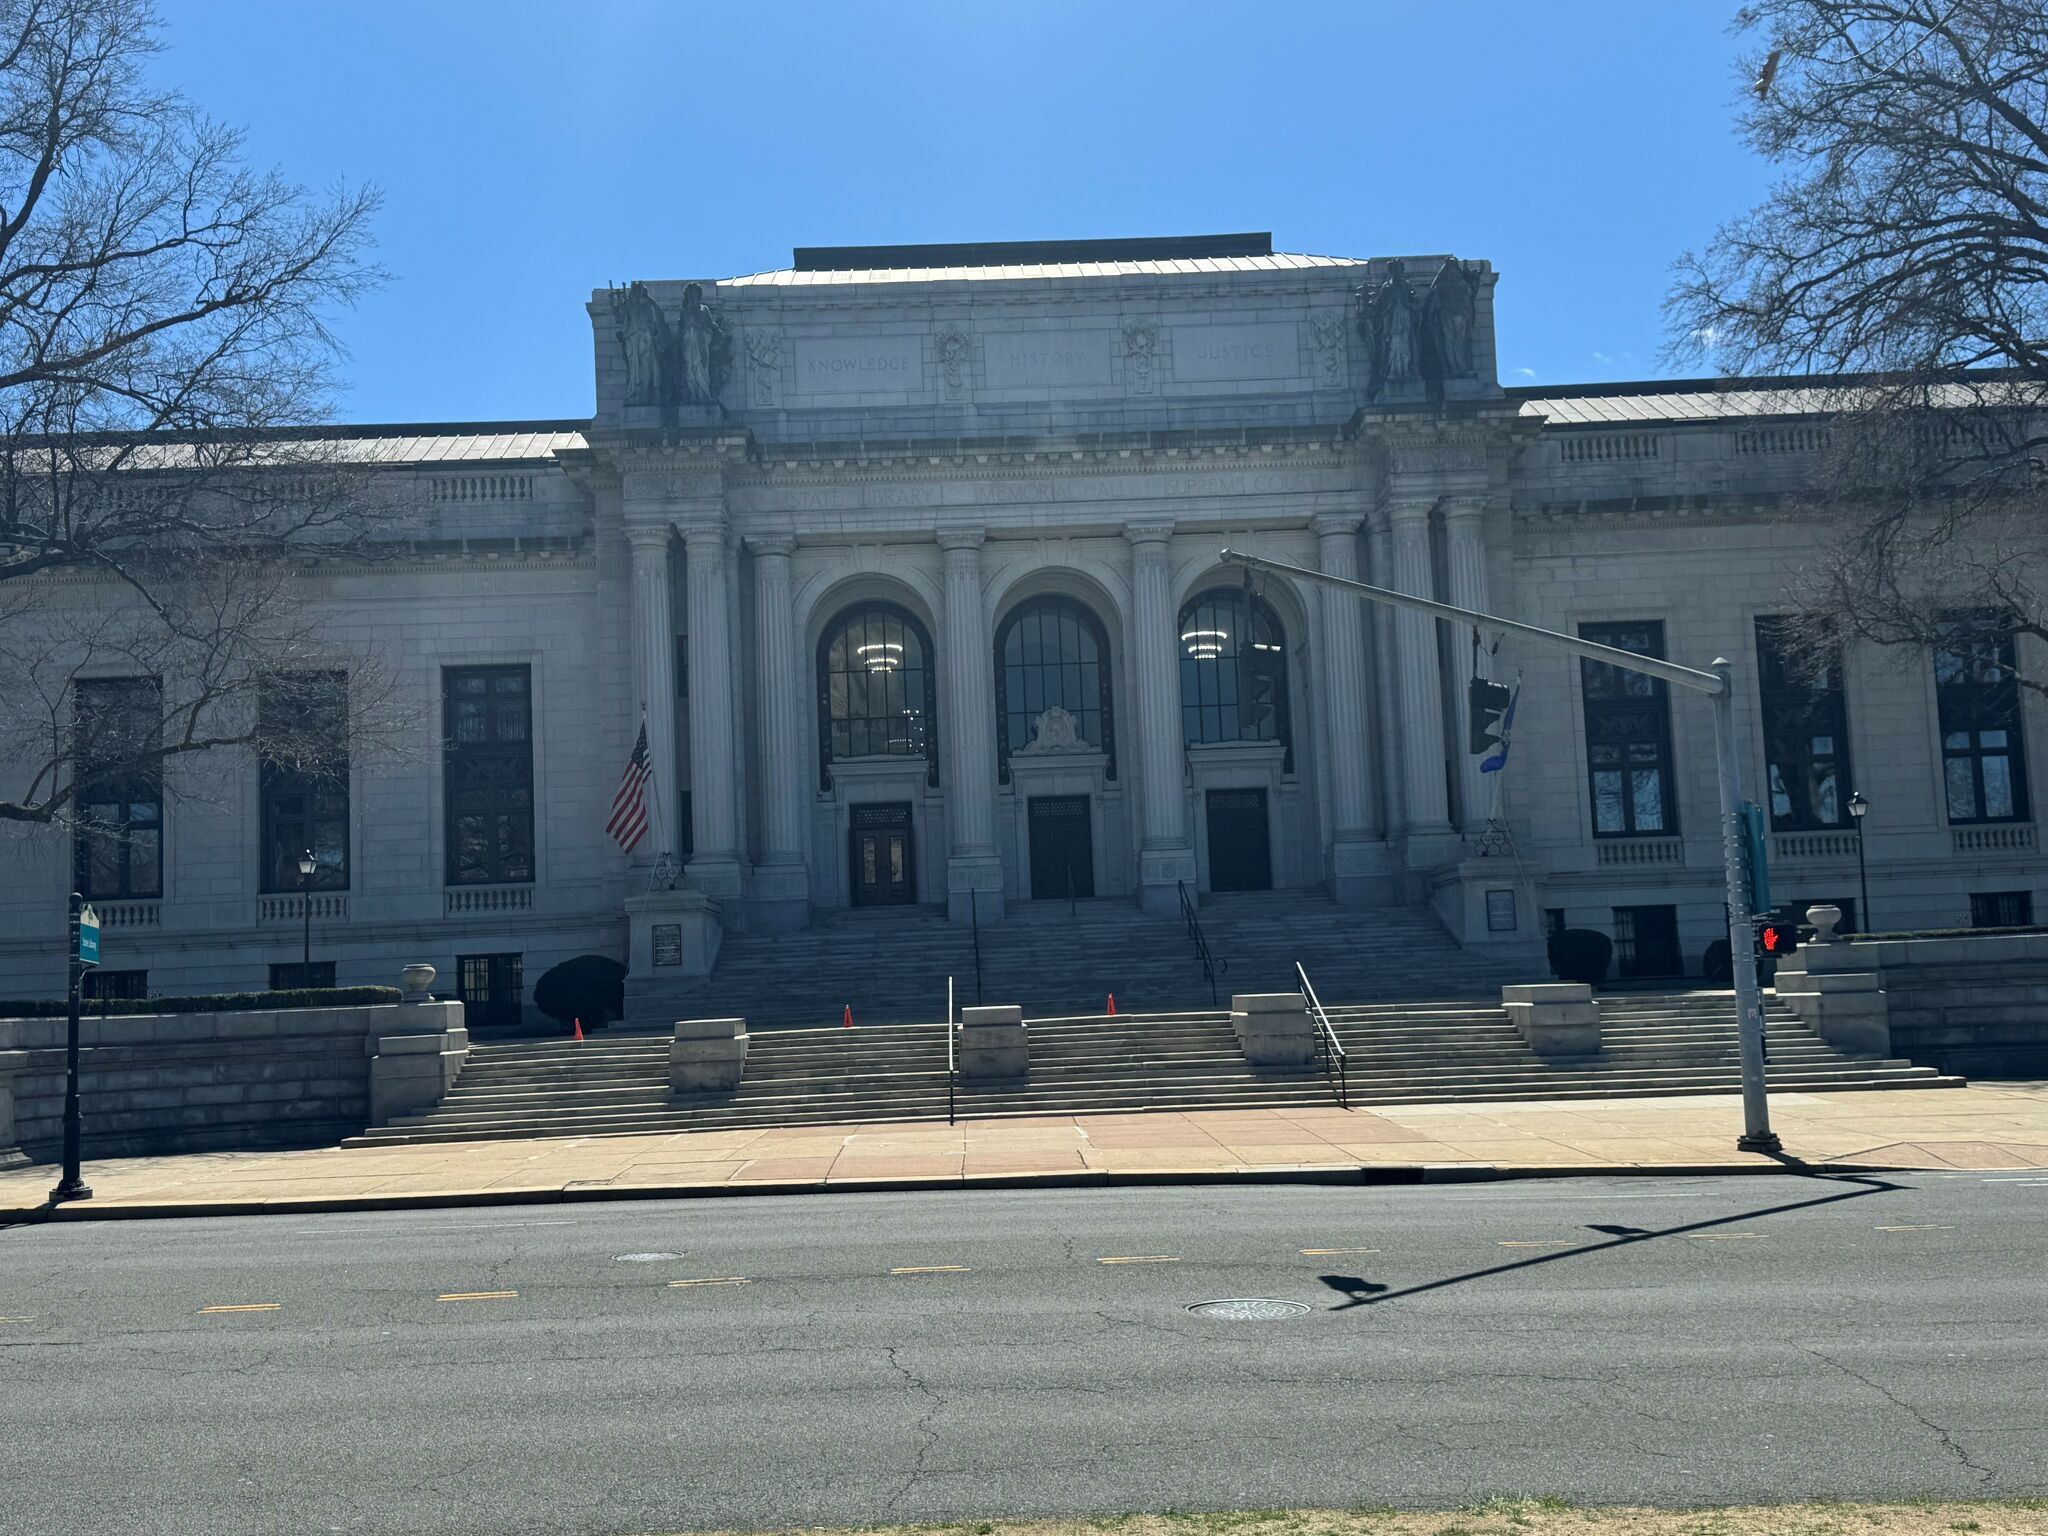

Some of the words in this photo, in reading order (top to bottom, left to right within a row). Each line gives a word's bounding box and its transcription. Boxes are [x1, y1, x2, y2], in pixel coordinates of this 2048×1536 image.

[1009, 351, 1085, 367] HISTORY
[1197, 344, 1274, 360] JUSTICE
[807, 356, 909, 372] KNOWLEDGE
[981, 482, 1078, 503] MEMORIAL
[1084, 480, 1125, 499] HALL
[1166, 477, 1244, 496] SUPREME
[1254, 473, 1319, 492] COURT
[788, 490, 842, 509] STATE
[857, 487, 934, 507] LIBRARY
